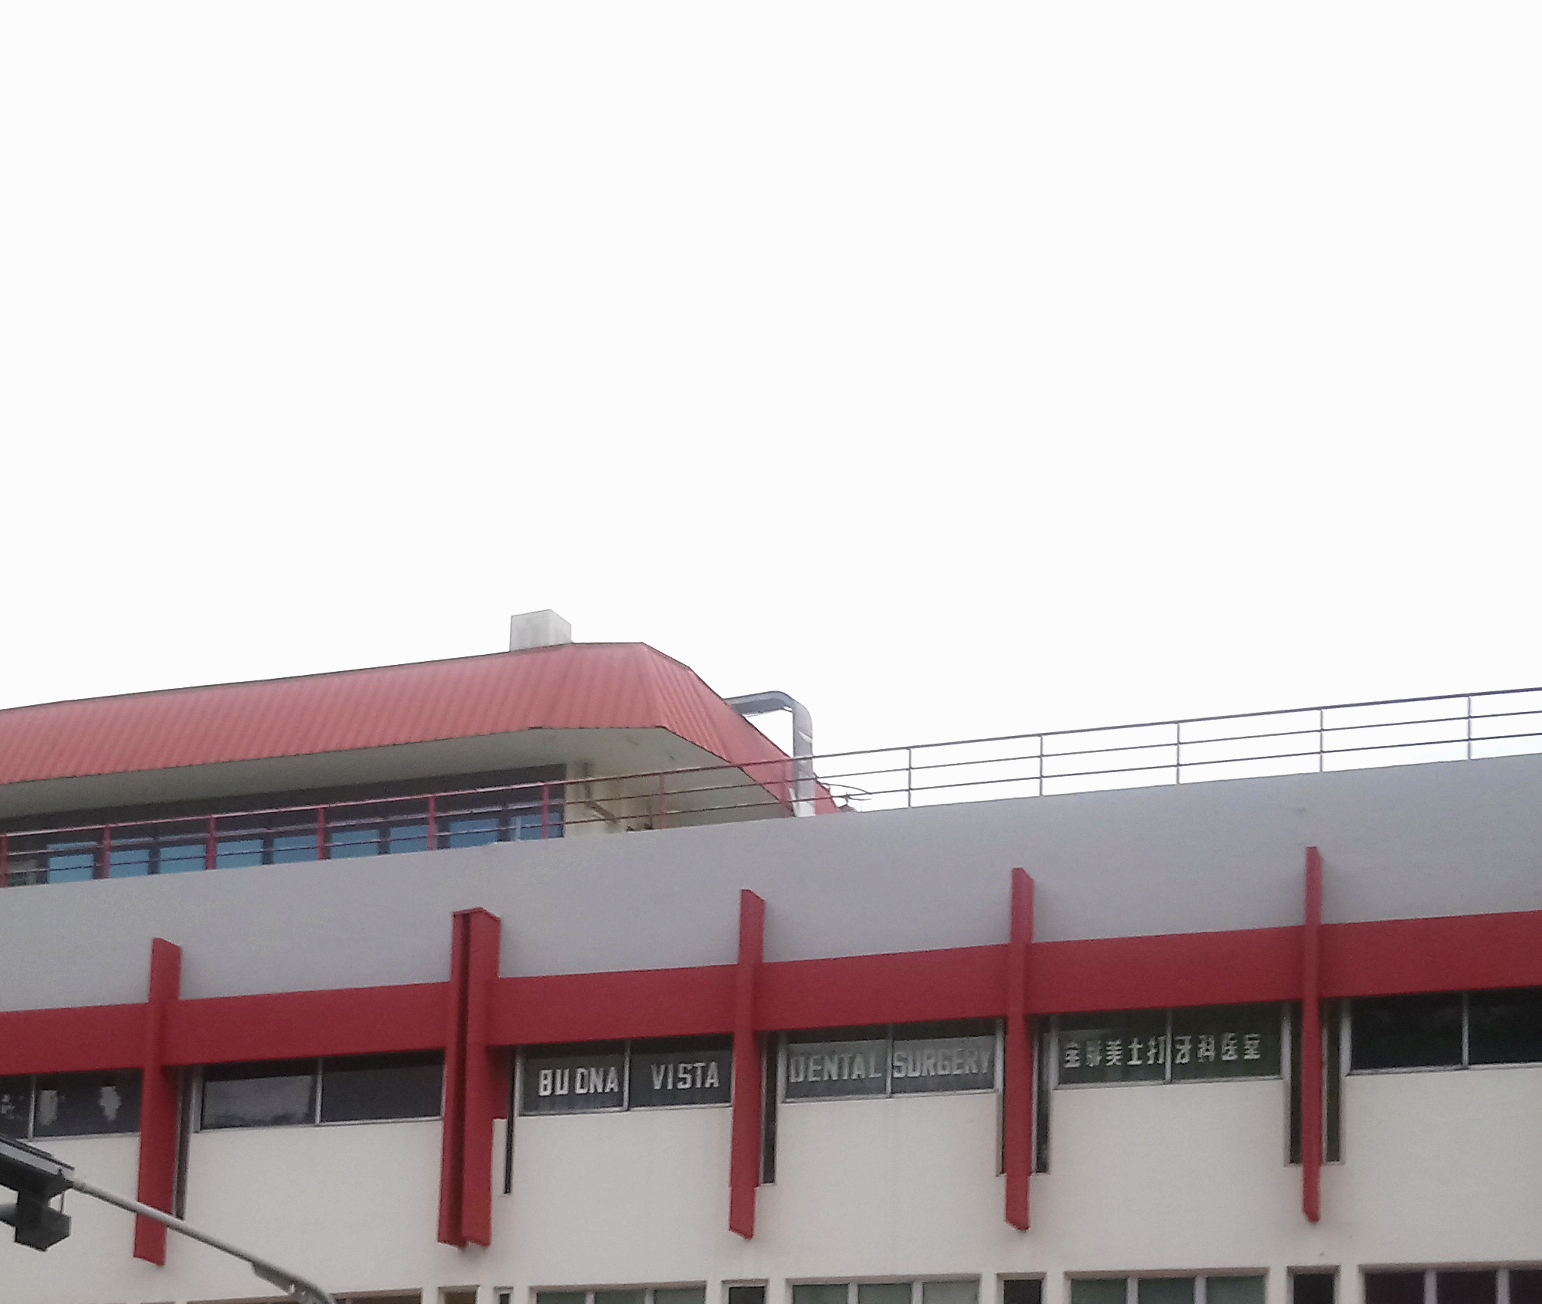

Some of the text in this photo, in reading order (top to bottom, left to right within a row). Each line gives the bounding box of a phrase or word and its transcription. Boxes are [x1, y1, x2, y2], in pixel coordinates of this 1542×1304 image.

[538, 1061, 720, 1096] BUONA VISTA
[788, 1047, 993, 1083] DENTAL SURGERY
